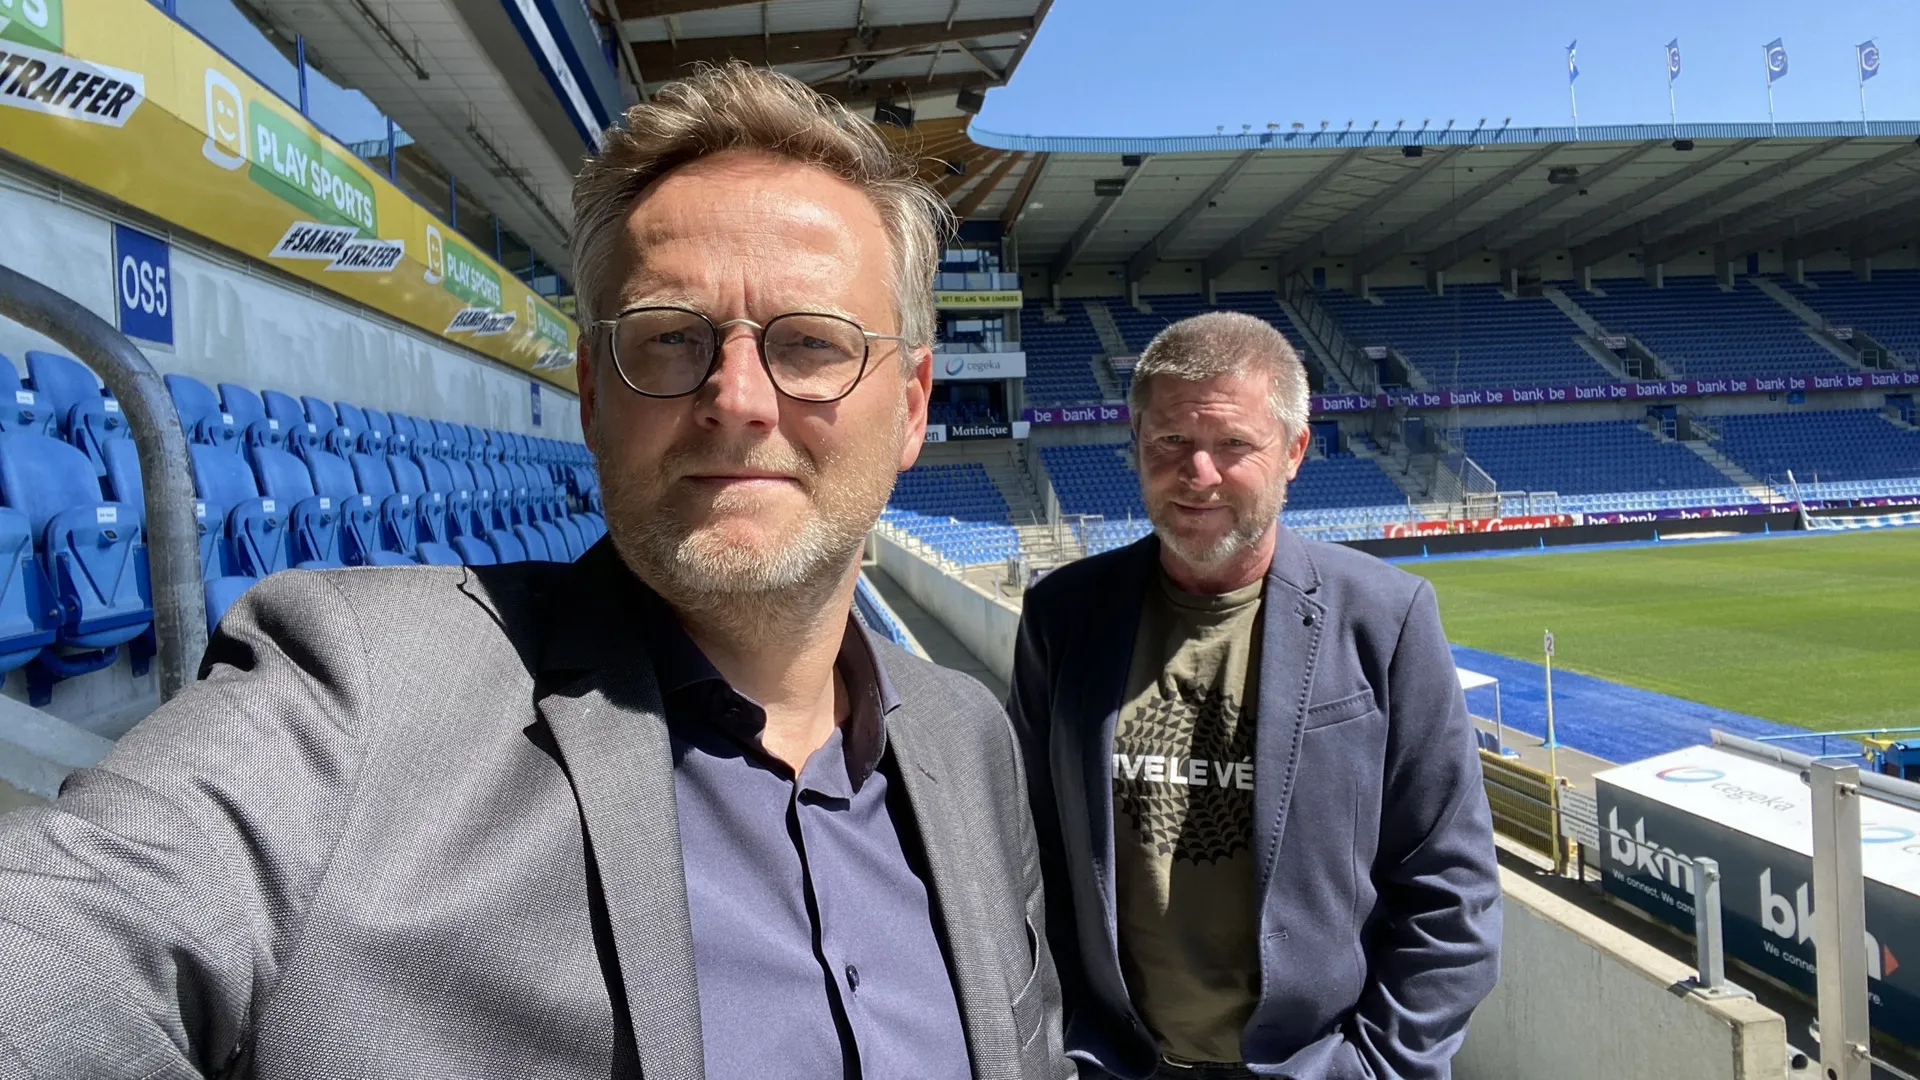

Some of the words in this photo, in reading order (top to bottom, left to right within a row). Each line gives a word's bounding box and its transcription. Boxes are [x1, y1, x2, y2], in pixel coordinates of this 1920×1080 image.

[0, 52, 136, 118] TRAFFER
[257, 124, 307, 187] PLAY
[310, 160, 373, 228] SPORTS
[281, 227, 352, 254] #SAMEN
[336, 244, 401, 268] STRAFFER
[122, 255, 167, 317] OS5
[447, 252, 471, 288] PLAY
[471, 269, 501, 306] SPORTS
[967, 360, 1000, 372] cegeka
[1323, 397, 1354, 410] bank
[1387, 393, 1419, 407] bnk
[1424, 393, 1440, 405] be
[1451, 391, 1481, 404] bank
[1487, 391, 1503, 403] be
[1513, 388, 1544, 401] bank
[1549, 388, 1565, 400] be
[1575, 386, 1606, 398] bank
[1611, 385, 1627, 397] be
[1636, 383, 1667, 396] bank
[1672, 382, 1687, 394] be
[1697, 380, 1727, 393] bank
[1731, 379, 1747, 391] be
[1756, 378, 1786, 390] bank
[1790, 377, 1805, 389] be
[1814, 376, 1843, 388] bank
[1848, 375, 1863, 386] be
[1871, 373, 1900, 385] bank
[1904, 372, 1919, 384] be
[952, 426, 1008, 437] Matinique
[1035, 410, 1052, 423] be
[1063, 408, 1096, 422] bank
[1101, 406, 1118, 419] be
[1546, 636, 1553, 652] 2
[1170, 757, 1208, 786] LE
[1214, 756, 1253, 790] VÉ
[1711, 782, 1796, 812] cegeka
[1609, 806, 1695, 896] bkm
[1612, 869, 1625, 882] We
[1661, 891, 1675, 906] We
[1763, 940, 1780, 957] We
[1782, 951, 1817, 974] conne
